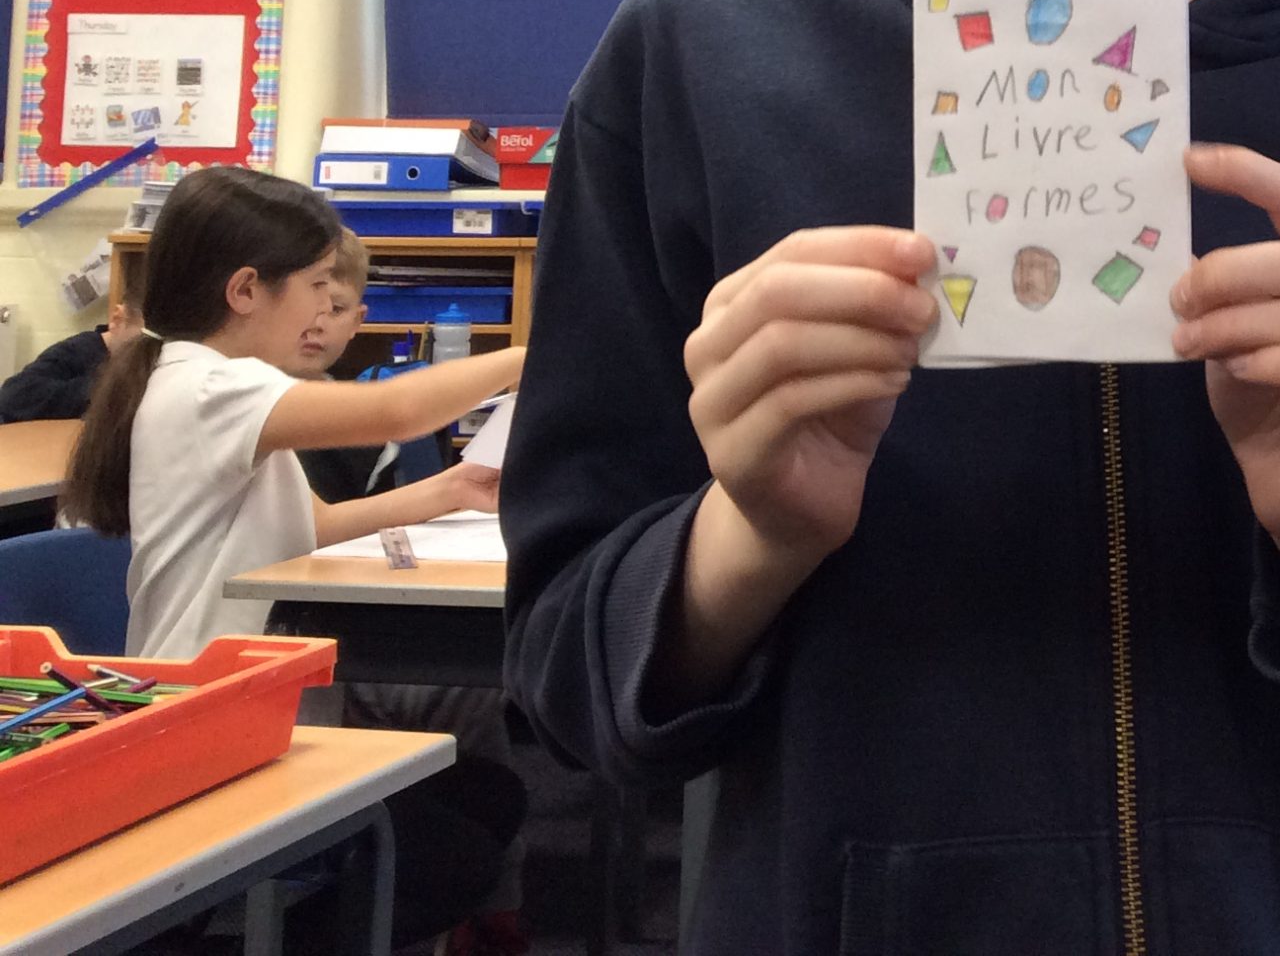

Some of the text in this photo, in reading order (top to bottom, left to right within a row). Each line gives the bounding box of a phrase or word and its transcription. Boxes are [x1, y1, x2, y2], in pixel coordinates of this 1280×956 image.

[975, 64, 1081, 107] Mon
[500, 134, 534, 147] Berol
[981, 115, 1098, 160] Livre
